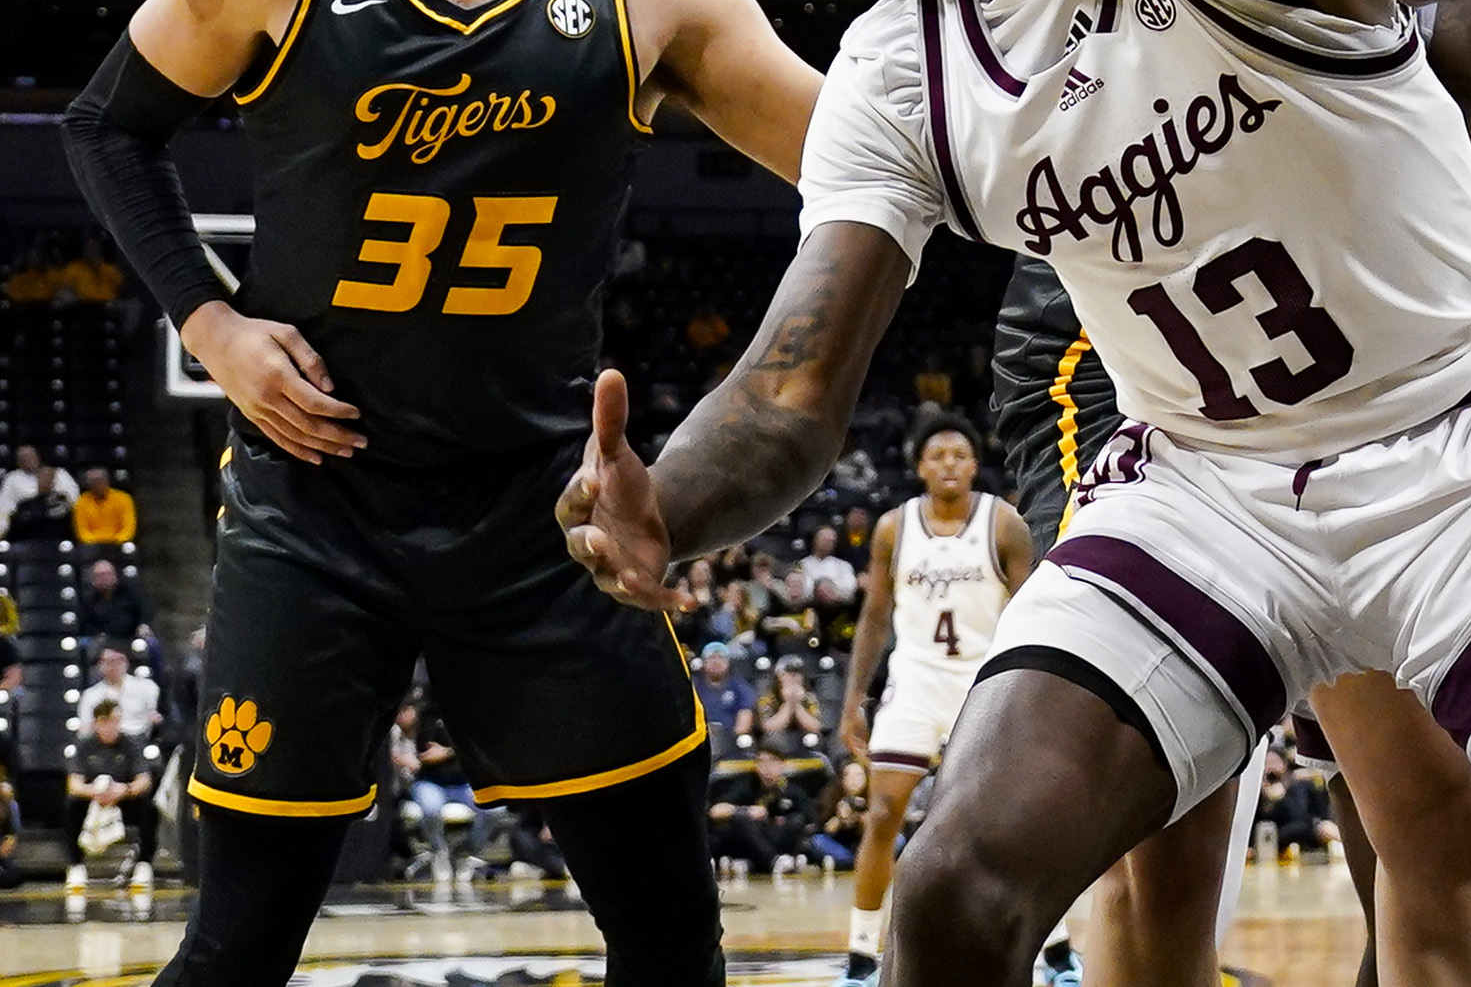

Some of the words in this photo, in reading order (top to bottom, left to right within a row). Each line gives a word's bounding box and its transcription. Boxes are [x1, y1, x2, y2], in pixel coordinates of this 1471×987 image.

[355, 73, 557, 164] Tigers
[1059, 78, 1105, 112] adidas
[1015, 73, 1283, 263] Aggies
[331, 192, 559, 316] 35
[1126, 236, 1355, 422] 13
[933, 610, 961, 657] 4
[217, 742, 246, 769] M
